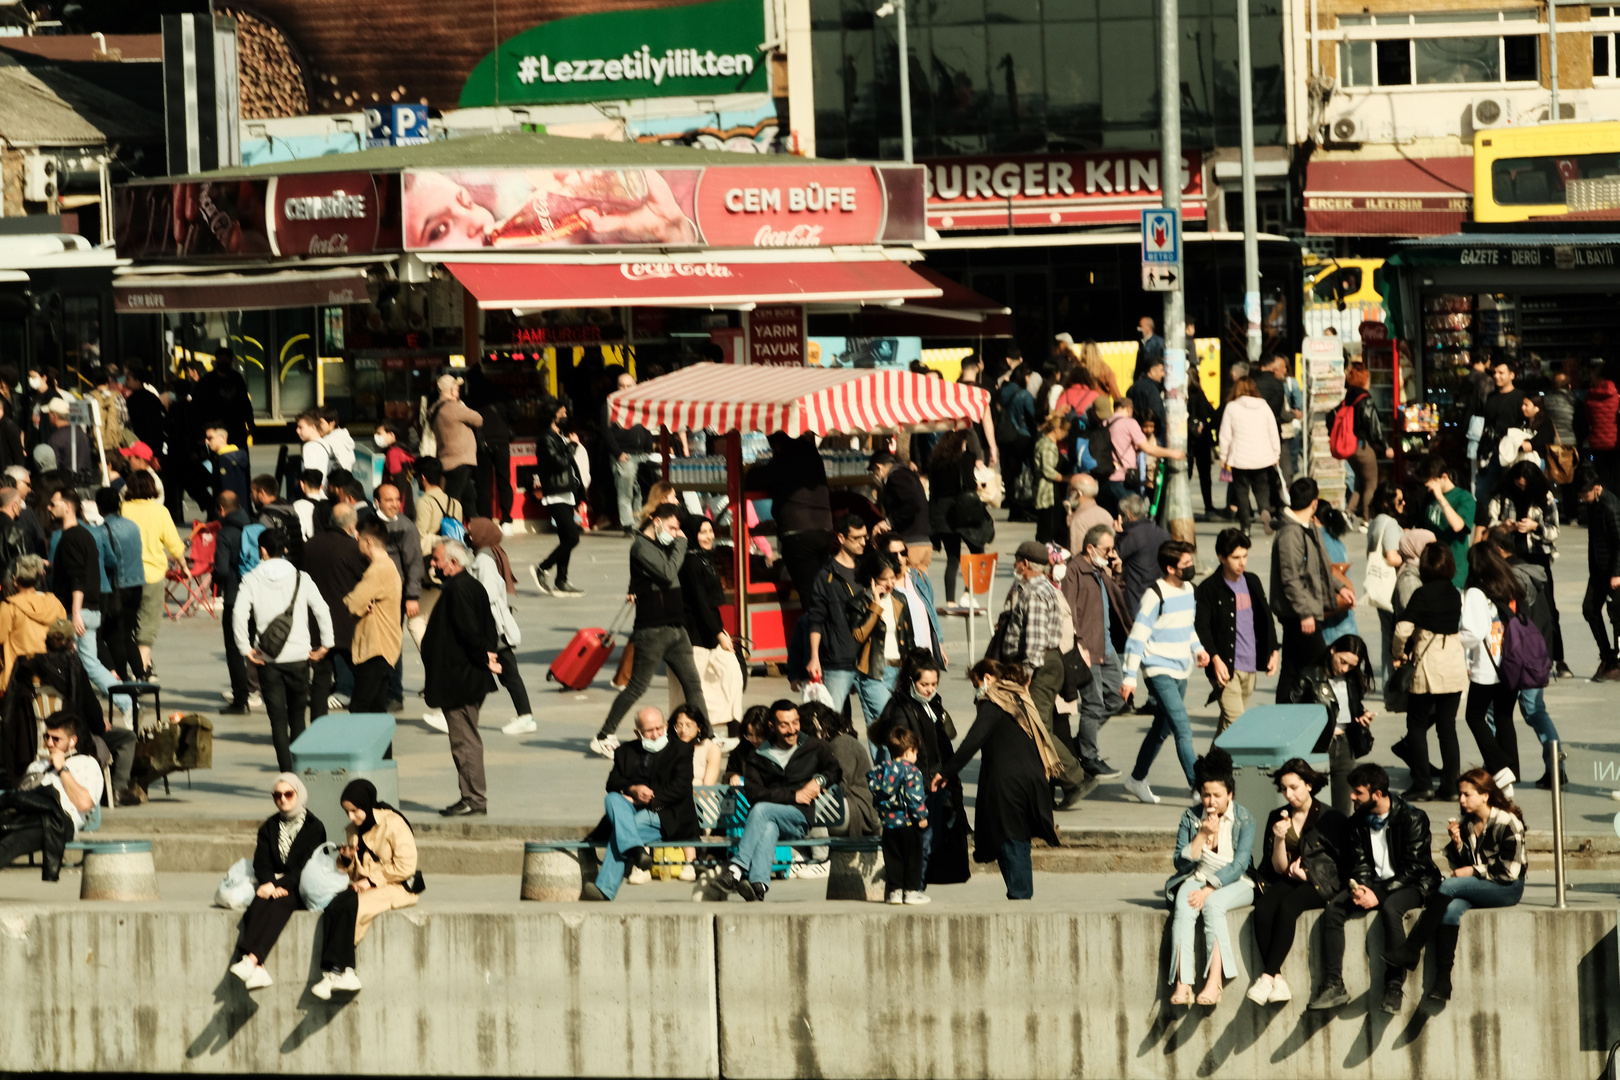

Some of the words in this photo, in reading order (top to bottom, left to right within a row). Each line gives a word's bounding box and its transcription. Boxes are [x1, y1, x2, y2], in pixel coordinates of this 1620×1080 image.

[365, 108, 382, 139] P
[397, 107, 417, 138] P
[725, 187, 781, 213] CEM
[788, 181, 857, 212] BÜFE
[1147, 252, 1174, 261] METRO
[1460, 248, 1499, 265] GAZETE
[753, 323, 798, 338] YARIM
[752, 342, 800, 357] TAVUK
